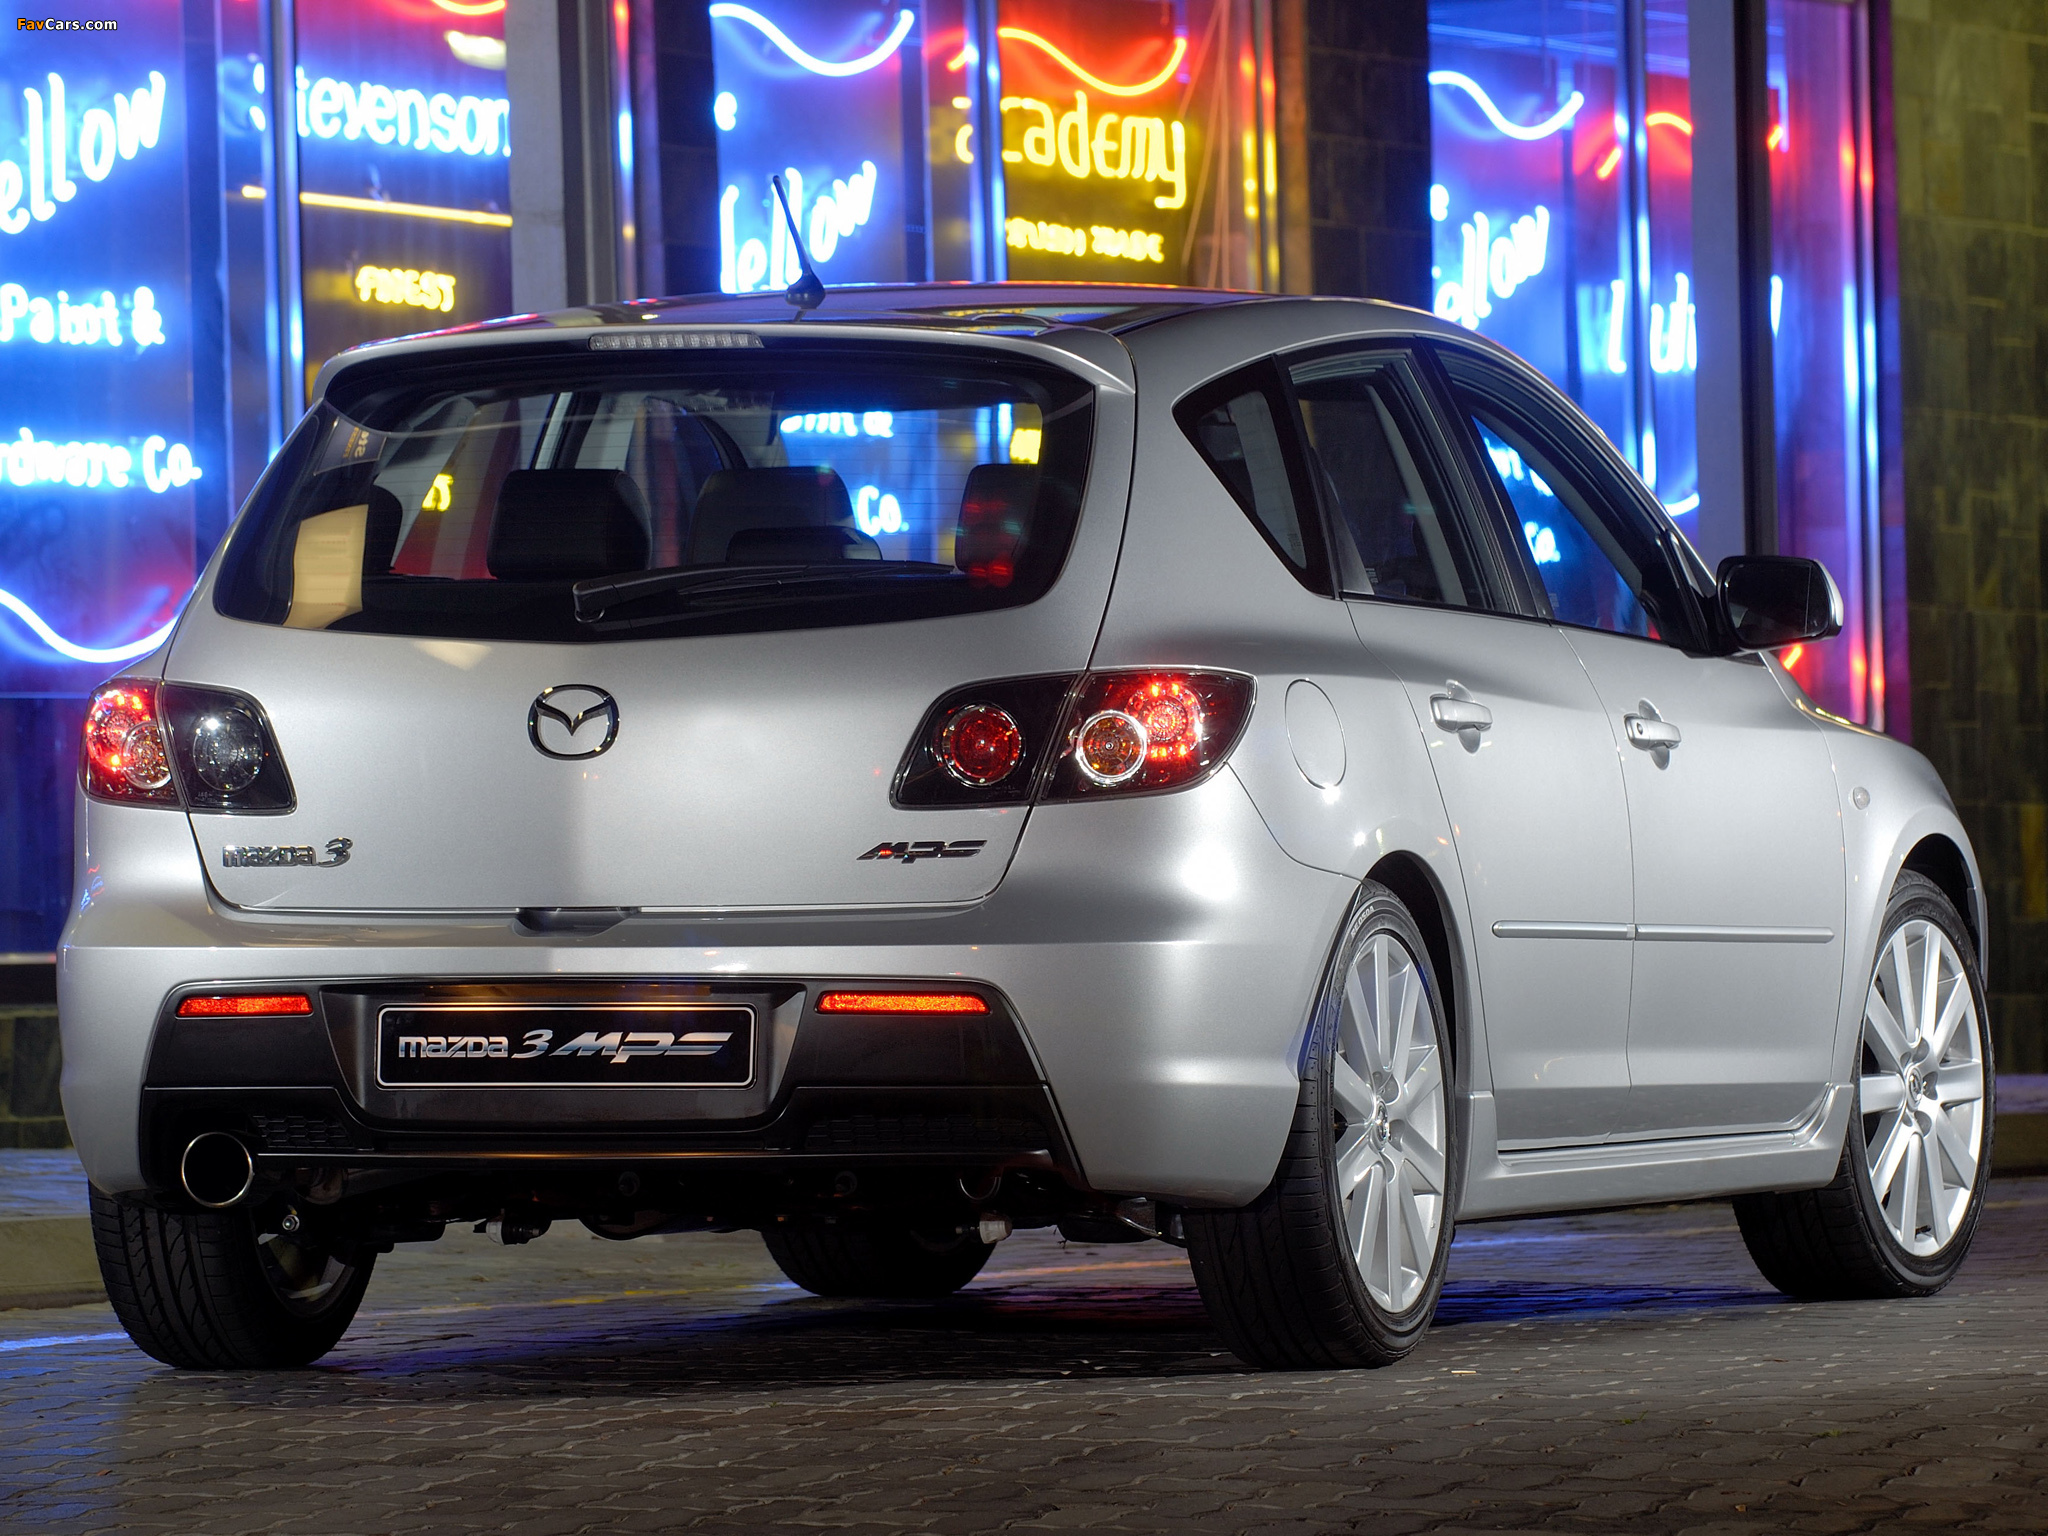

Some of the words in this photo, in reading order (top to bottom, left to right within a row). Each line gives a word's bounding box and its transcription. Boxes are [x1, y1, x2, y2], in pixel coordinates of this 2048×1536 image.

[0, 282, 124, 348] Paint
[142, 434, 203, 494] Co.
[317, 837, 354, 868] 3
[511, 1028, 553, 1059] 3
